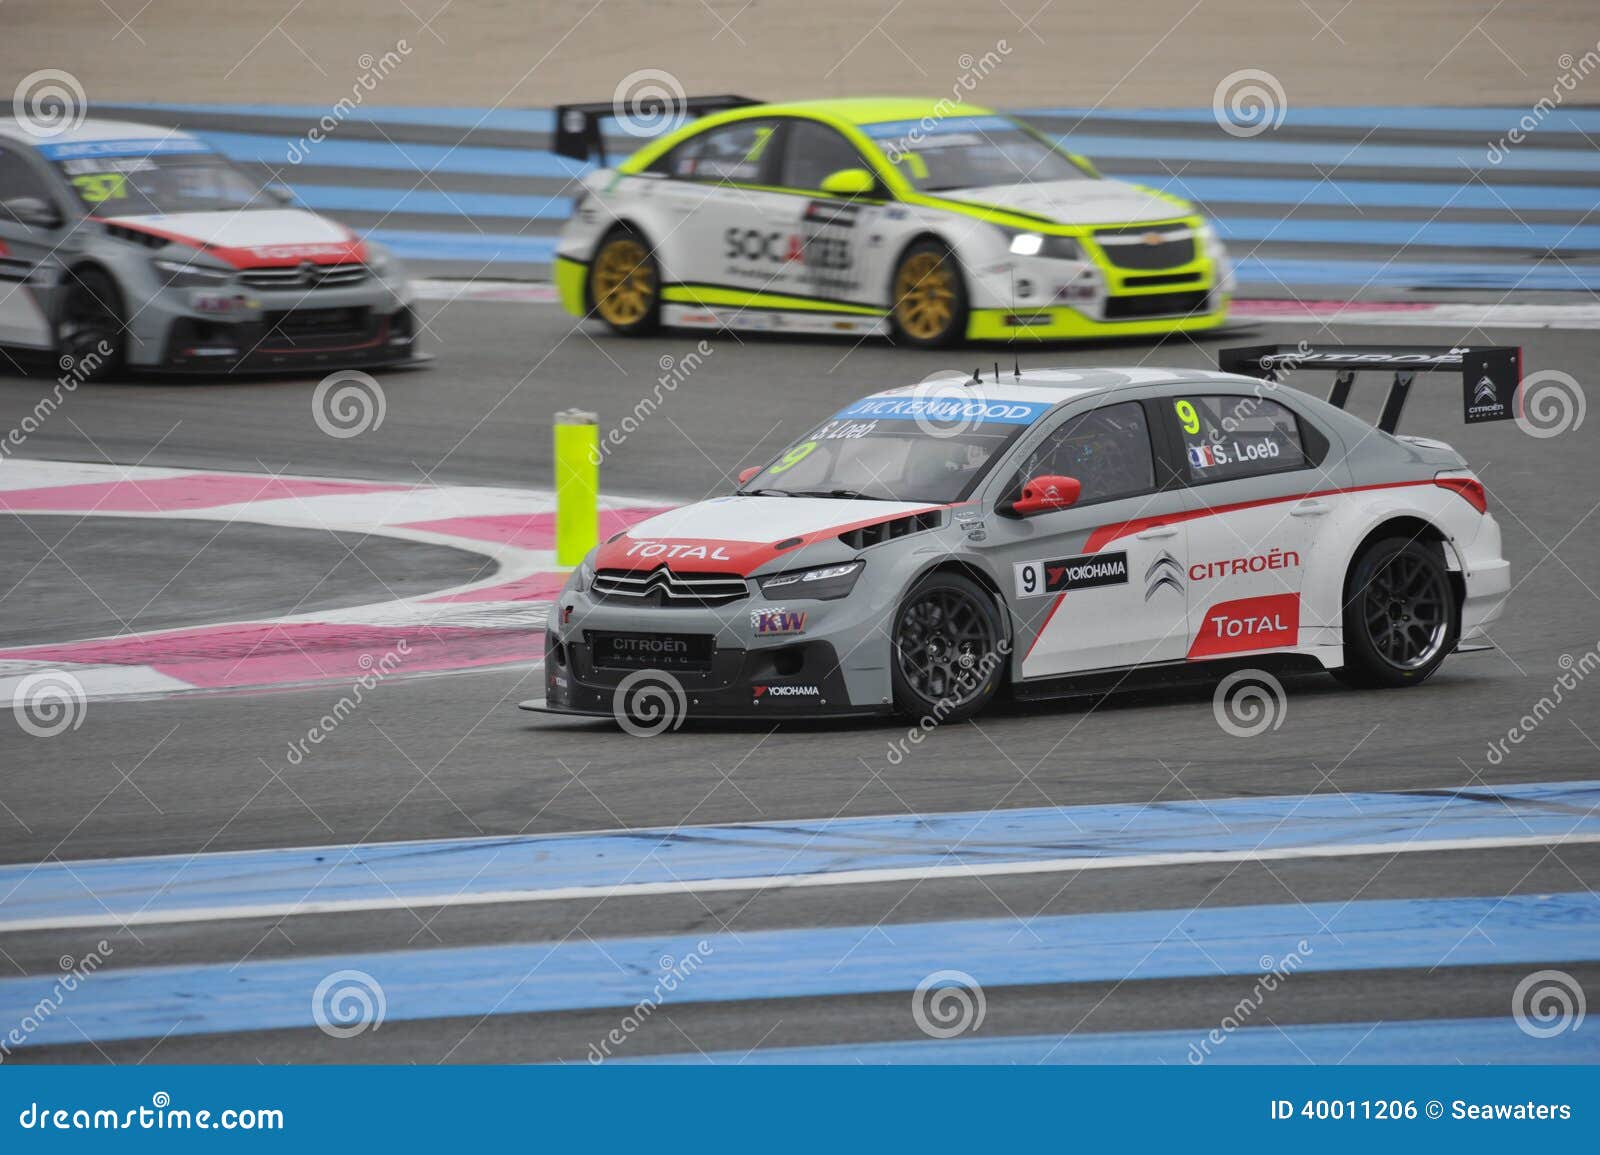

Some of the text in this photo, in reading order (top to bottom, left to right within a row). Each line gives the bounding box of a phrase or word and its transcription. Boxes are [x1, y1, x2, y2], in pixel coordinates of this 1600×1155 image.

[72, 173, 127, 202] 37
[1174, 400, 1200, 435] 9
[769, 441, 817, 474] 9
[1212, 437, 1280, 465] S. Loeb
[626, 541, 730, 561] TOTAL
[1021, 560, 1126, 593] 9 YOKOHAMA
[758, 611, 808, 633] KW
[1211, 613, 1289, 637] TOTAL
[767, 686, 819, 696] YOKOHAMA
